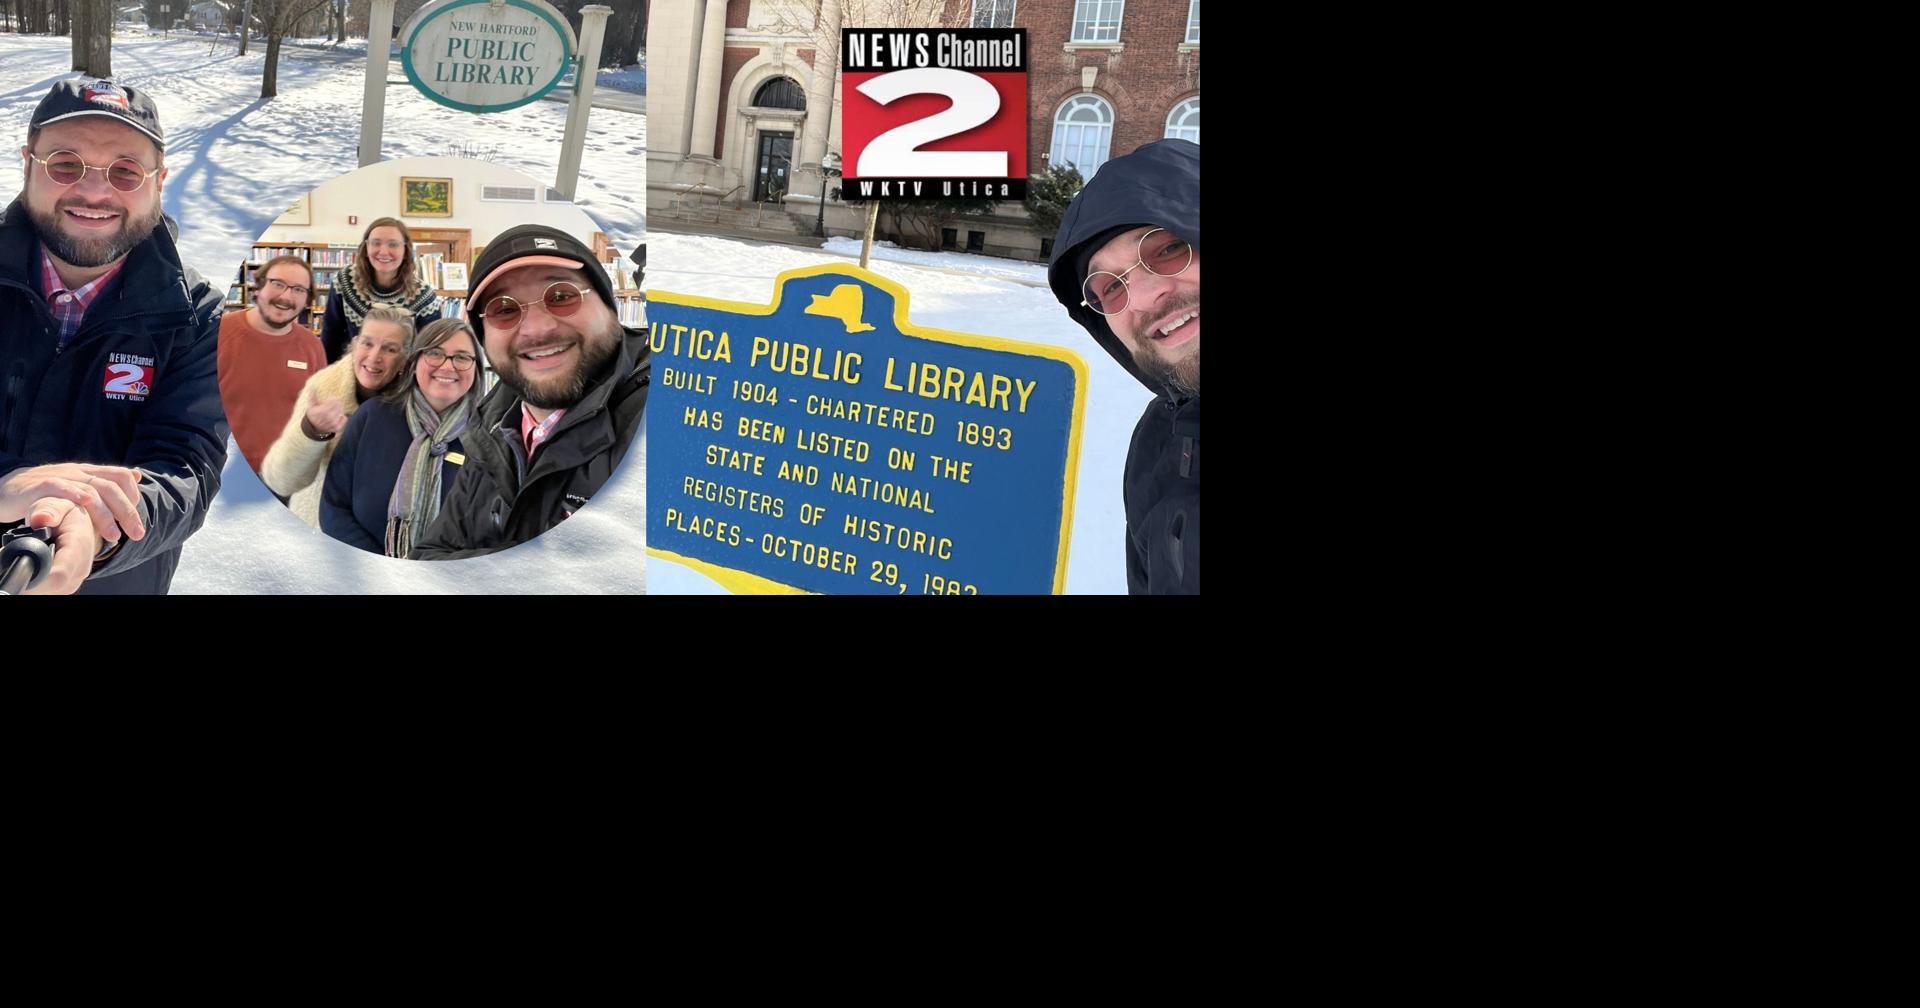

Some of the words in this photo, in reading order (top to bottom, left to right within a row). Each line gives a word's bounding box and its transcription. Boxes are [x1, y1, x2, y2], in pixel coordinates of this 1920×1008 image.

[449, 21, 476, 32] NEW
[480, 23, 537, 36] HARTFORD
[446, 37, 536, 62] PUBLIC
[435, 62, 540, 86] LIBRARY
[104, 363, 145, 393] 2
[650, 321, 732, 364] UTICA
[750, 336, 862, 385] PUBLIC
[884, 357, 1037, 413] LIBRARY
[105, 392, 126, 401] WKTV
[128, 394, 145, 402] Utica
[662, 367, 717, 396] BUILT
[732, 380, 778, 406] 1904
[806, 394, 935, 436] CHARTERED
[956, 421, 1013, 451] 1893
[683, 406, 723, 431] HAS
[737, 416, 786, 445] BEEN
[796, 429, 870, 463] LISTED
[887, 447, 916, 472] ON
[930, 455, 974, 484] THE
[706, 444, 766, 477] STATE
[778, 460, 820, 486] AND
[831, 471, 935, 514] NATIONAL
[683, 476, 785, 519] REGISTERS
[799, 503, 826, 527] OF
[843, 514, 953, 560] HISTORIC
[869, 560, 908, 595] 29,
